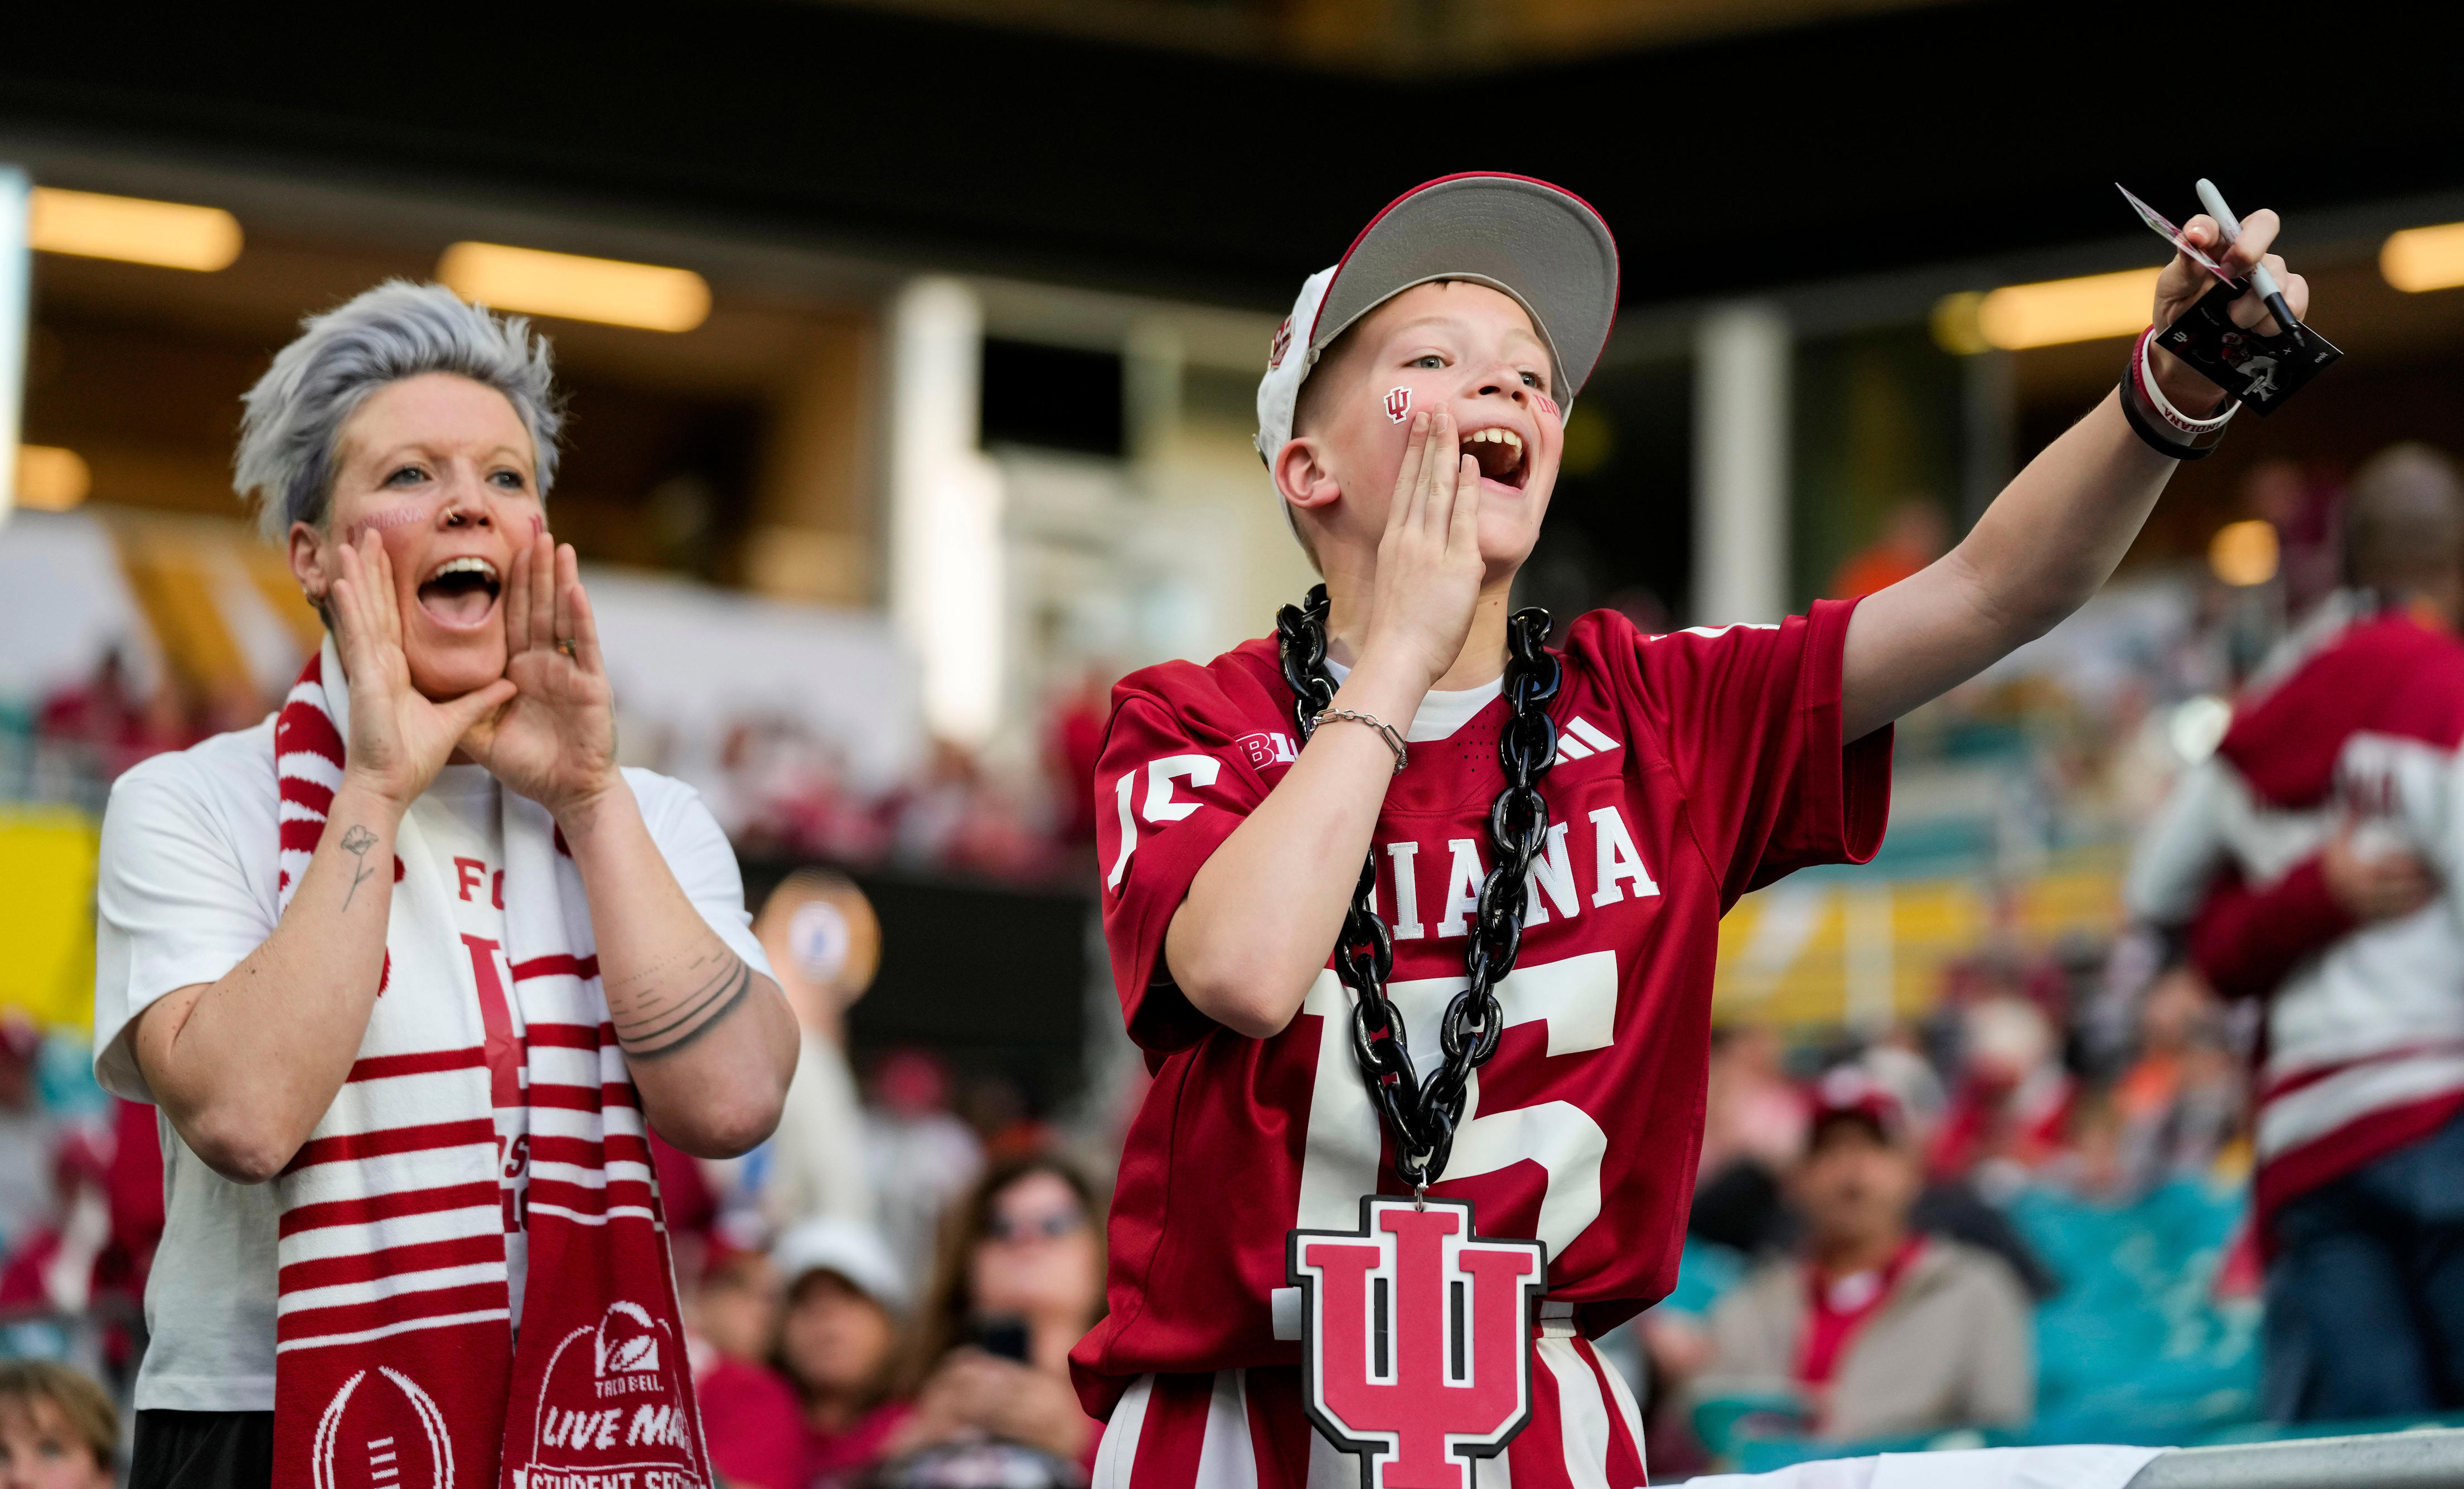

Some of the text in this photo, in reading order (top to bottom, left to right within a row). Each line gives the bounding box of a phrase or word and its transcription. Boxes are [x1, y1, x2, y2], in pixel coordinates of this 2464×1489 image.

[2163, 406, 2220, 433] INDIANA
[1236, 732, 1300, 771] B1
[1369, 806, 1661, 941] IANA
[1273, 950, 1619, 1340] 15
[594, 1380, 626, 1399] TACO
[542, 1405, 623, 1450] LIVE
